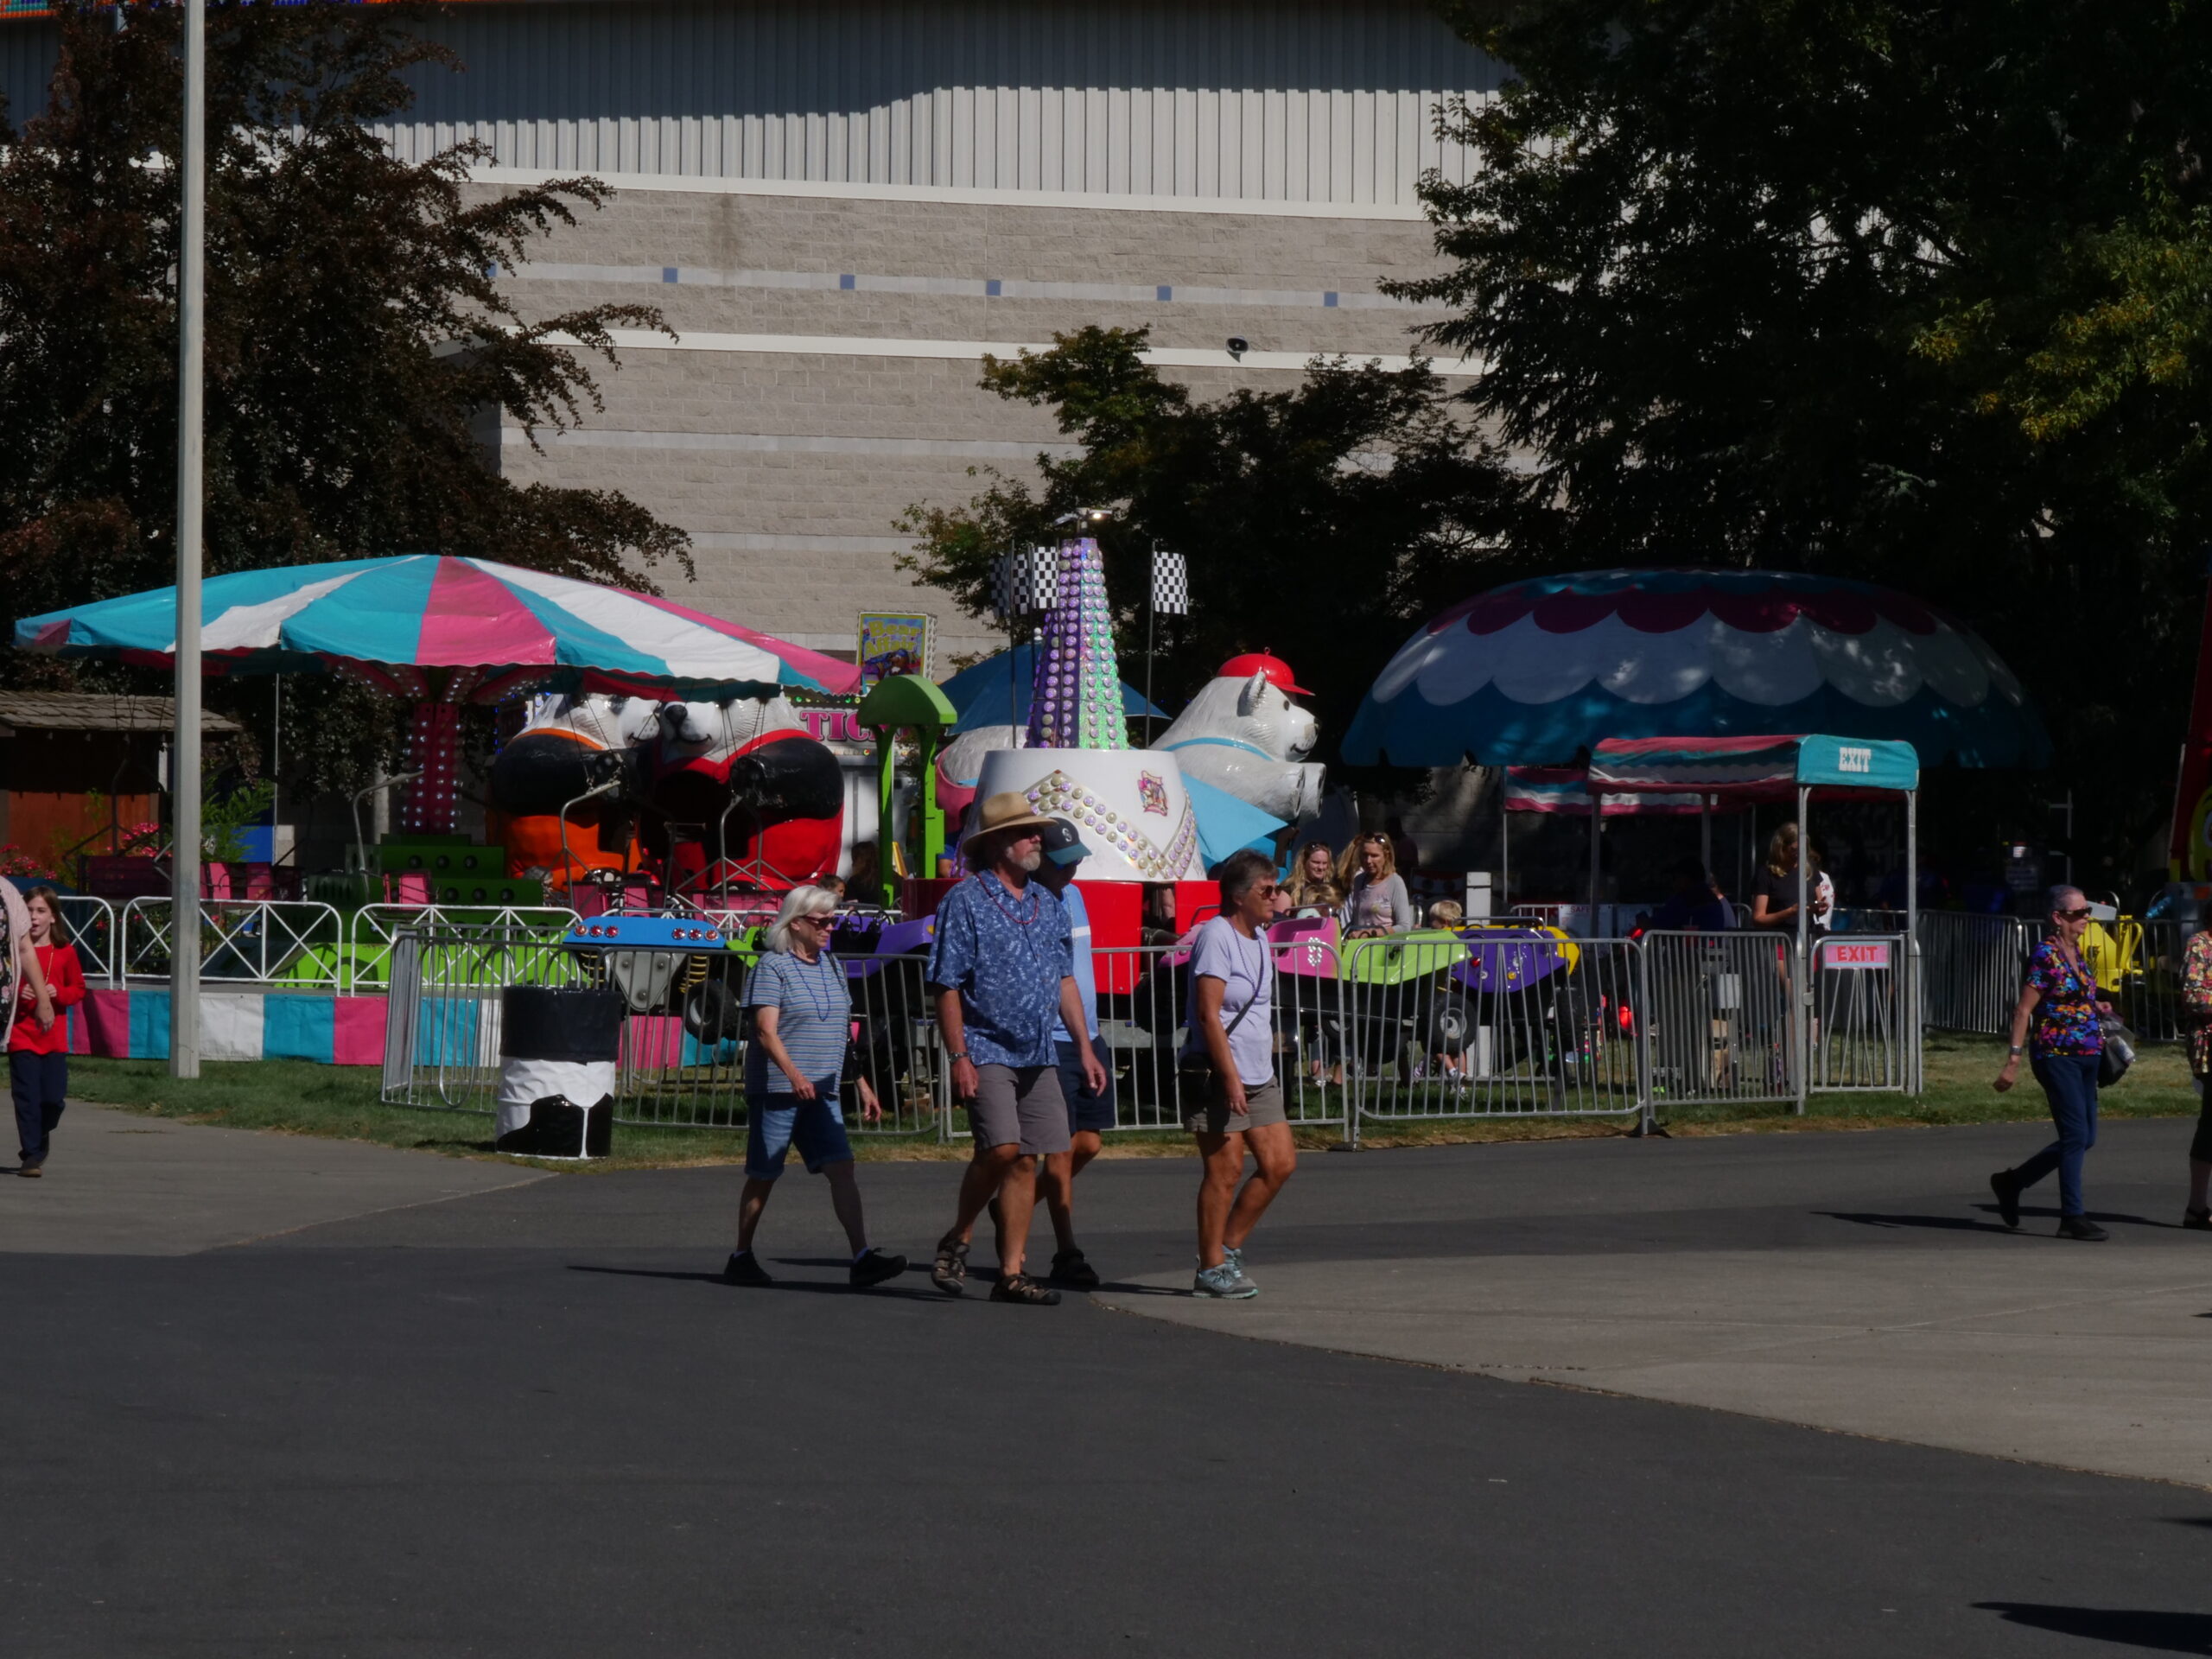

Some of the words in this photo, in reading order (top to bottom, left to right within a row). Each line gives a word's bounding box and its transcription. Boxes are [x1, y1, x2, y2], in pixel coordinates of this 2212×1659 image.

[868, 620, 922, 639] Bear
[864, 638, 917, 659] Affair
[1839, 747, 1872, 773] EXIT
[1837, 946, 1878, 962] EXIT
